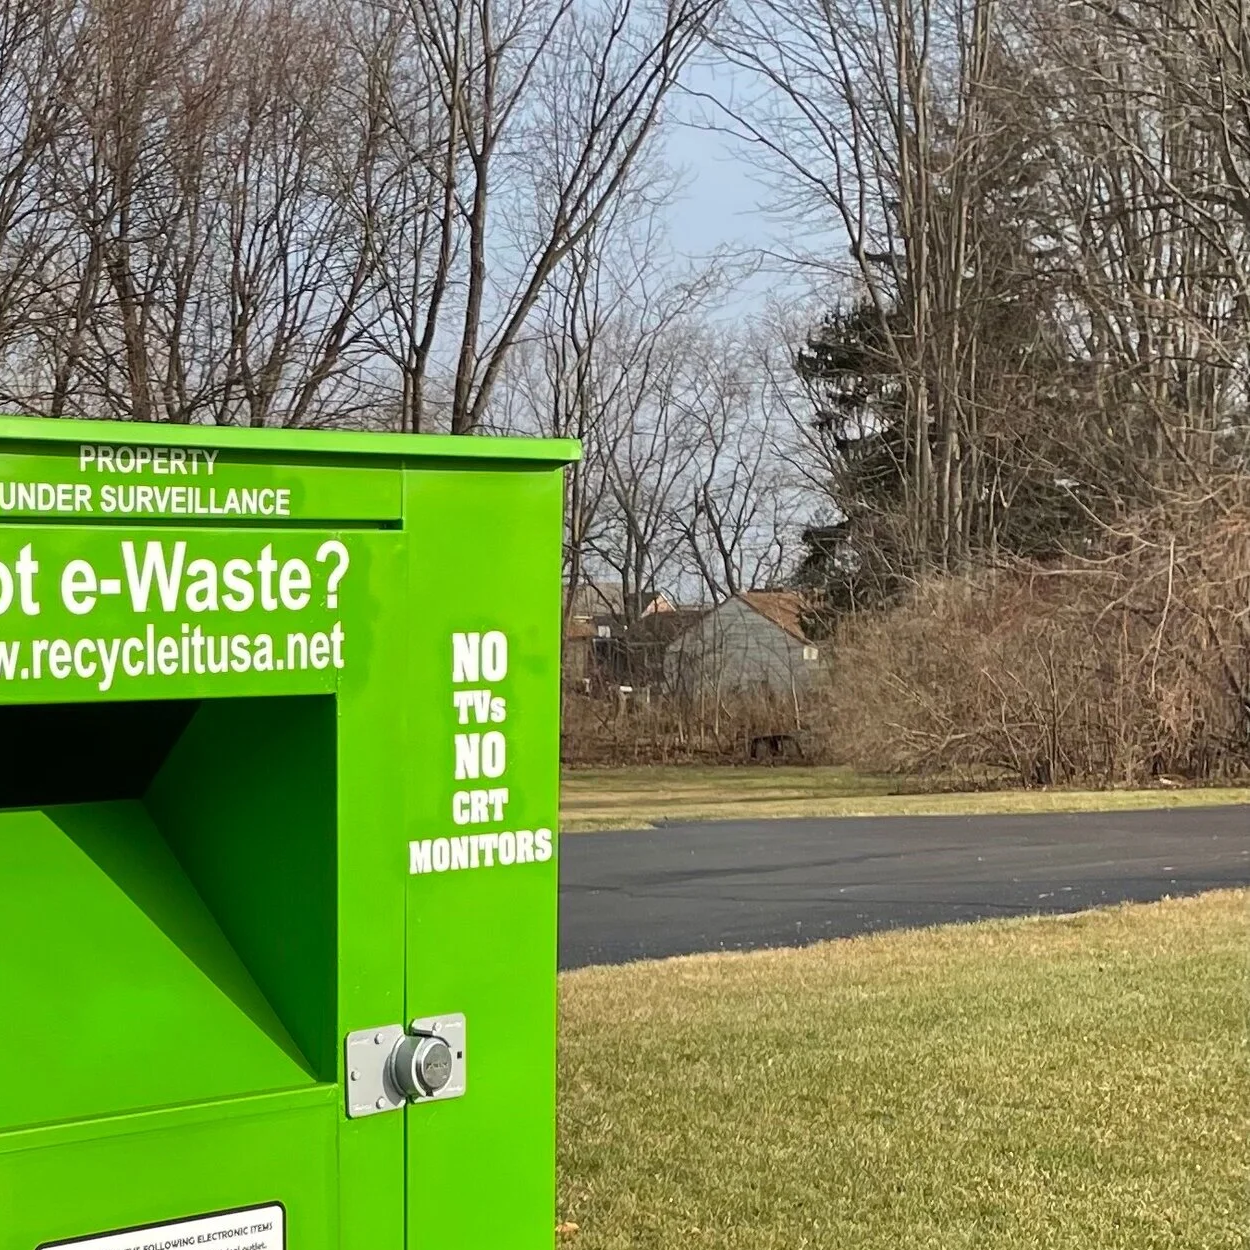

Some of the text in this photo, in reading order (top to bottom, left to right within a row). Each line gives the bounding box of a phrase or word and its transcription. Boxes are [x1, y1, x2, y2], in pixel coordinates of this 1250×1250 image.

[79, 445, 219, 476] PROPERTY
[100, 484, 291, 516] SURVEILLANCE
[61, 539, 350, 615] e-Waste?
[452, 630, 508, 683] NO
[453, 690, 506, 725] TVs
[454, 732, 506, 780] NO
[452, 788, 509, 825] CRT
[408, 828, 552, 875] MONITORS
[197, 1226, 248, 1244] ELECTRONIC
[250, 1222, 273, 1235] ITEMS
